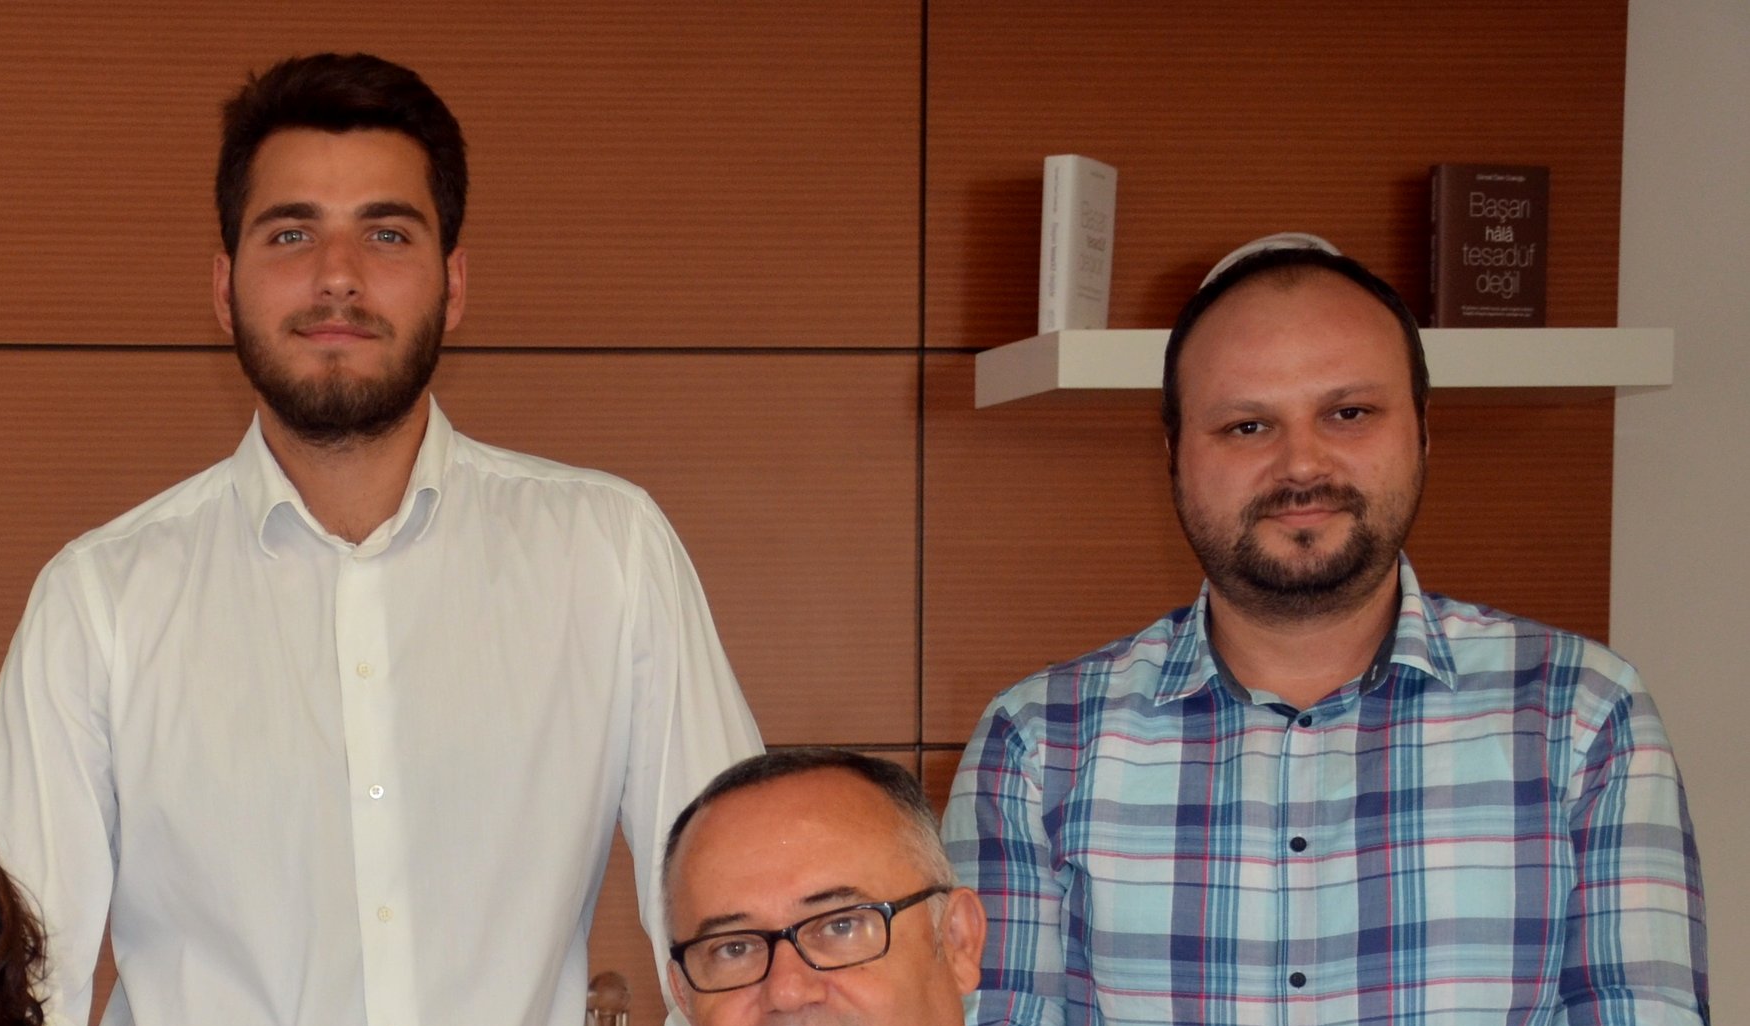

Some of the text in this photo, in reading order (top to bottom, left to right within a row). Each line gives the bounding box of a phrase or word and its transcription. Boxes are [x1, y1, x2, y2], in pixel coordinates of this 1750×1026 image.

[1469, 191, 1531, 223] Başarı
[1462, 242, 1536, 267] tesadüf
[1476, 271, 1520, 299] değil
